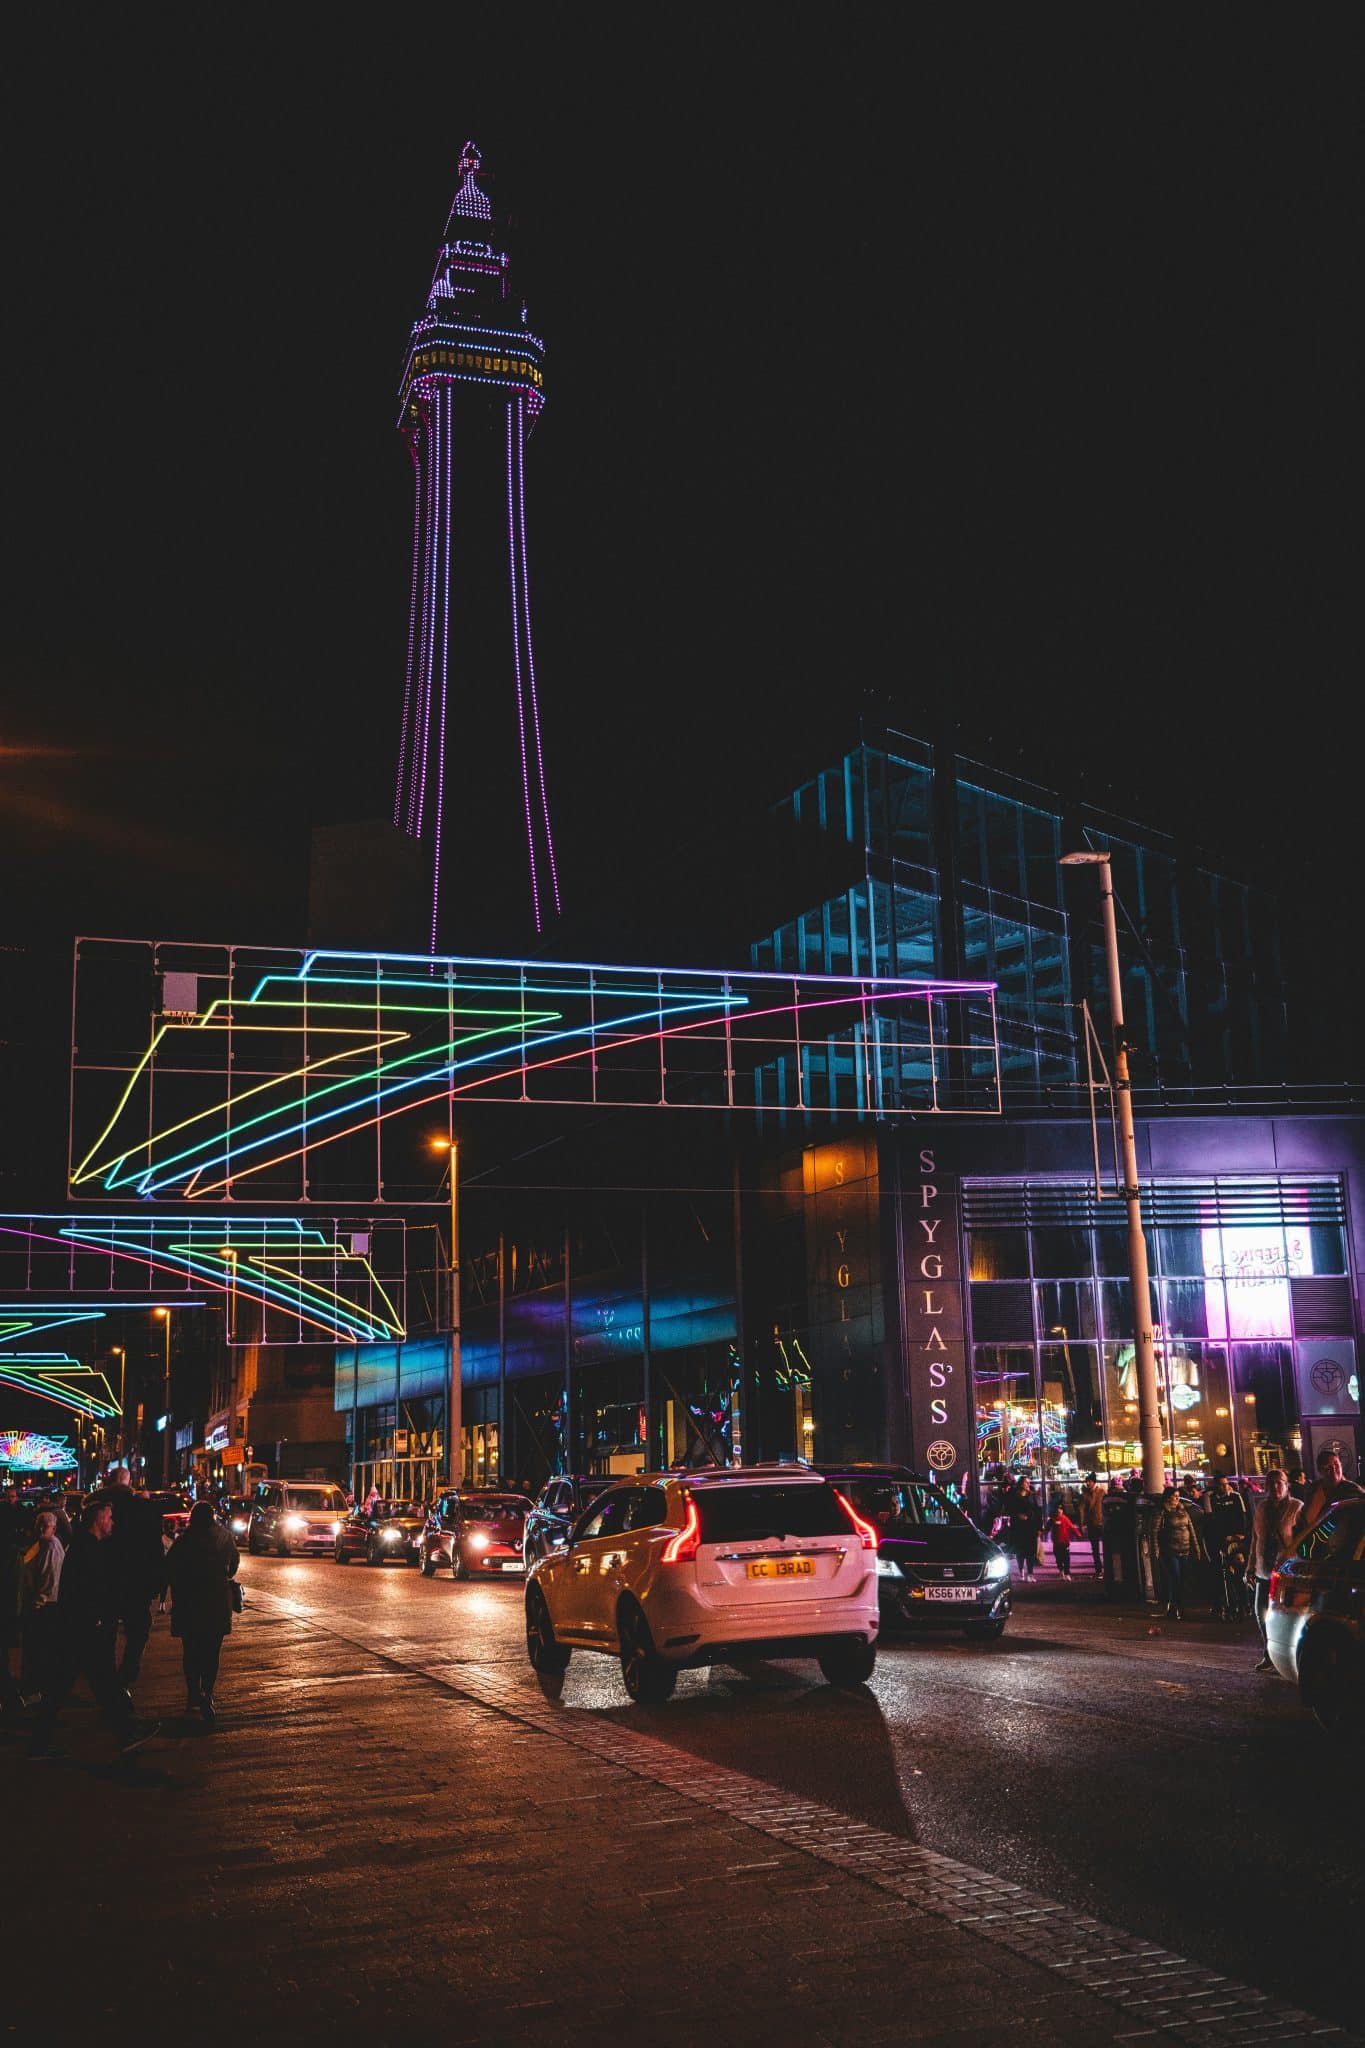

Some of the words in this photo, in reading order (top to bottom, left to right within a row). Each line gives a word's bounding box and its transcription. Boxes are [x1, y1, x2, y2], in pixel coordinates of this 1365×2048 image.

[919, 1149, 948, 1425] SPYGLASS
[752, 1564, 768, 1577] CC
[928, 1588, 953, 1598] KS66
